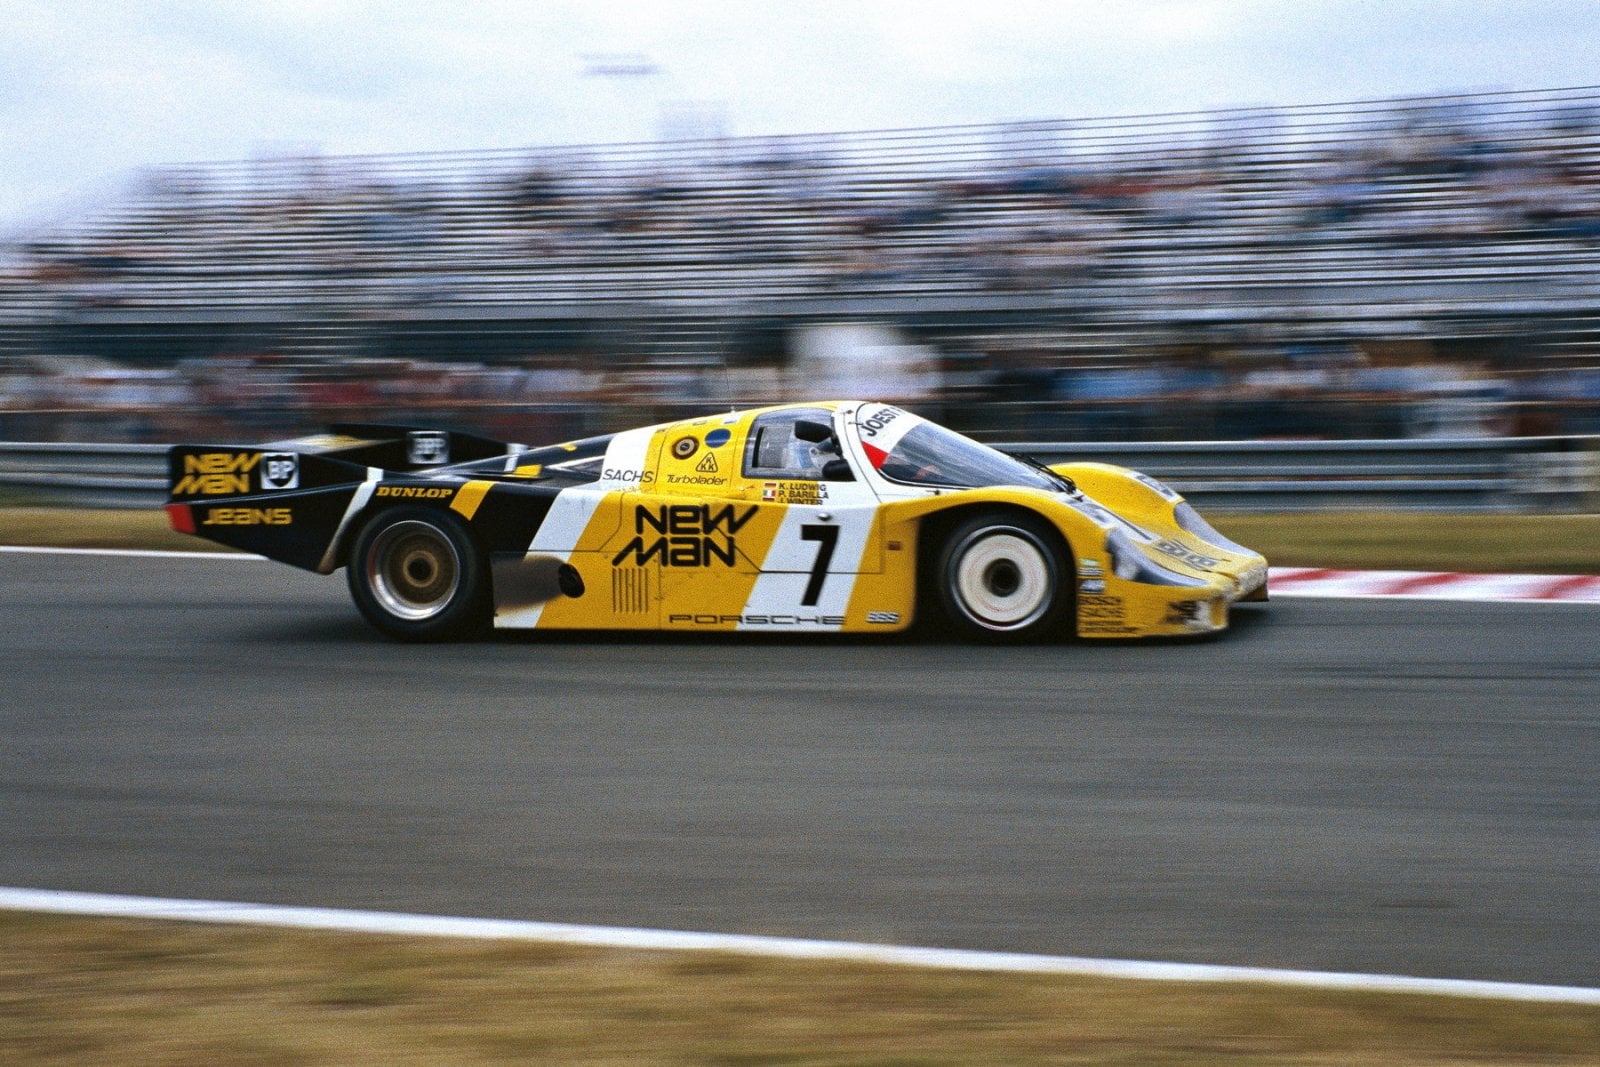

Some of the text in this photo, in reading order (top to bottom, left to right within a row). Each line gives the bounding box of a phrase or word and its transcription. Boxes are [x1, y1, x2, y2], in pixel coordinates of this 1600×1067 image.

[268, 460, 294, 479] BP
[602, 468, 655, 483] SACHS
[667, 473, 728, 486] Turbolader
[376, 486, 453, 499] DUNLOP
[779, 482, 827, 492] K. LUDWIG
[778, 490, 829, 499] P. BARILLA
[787, 497, 823, 505] WINTER
[801, 524, 841, 607] 7
[669, 614, 847, 625] PORSCHE
